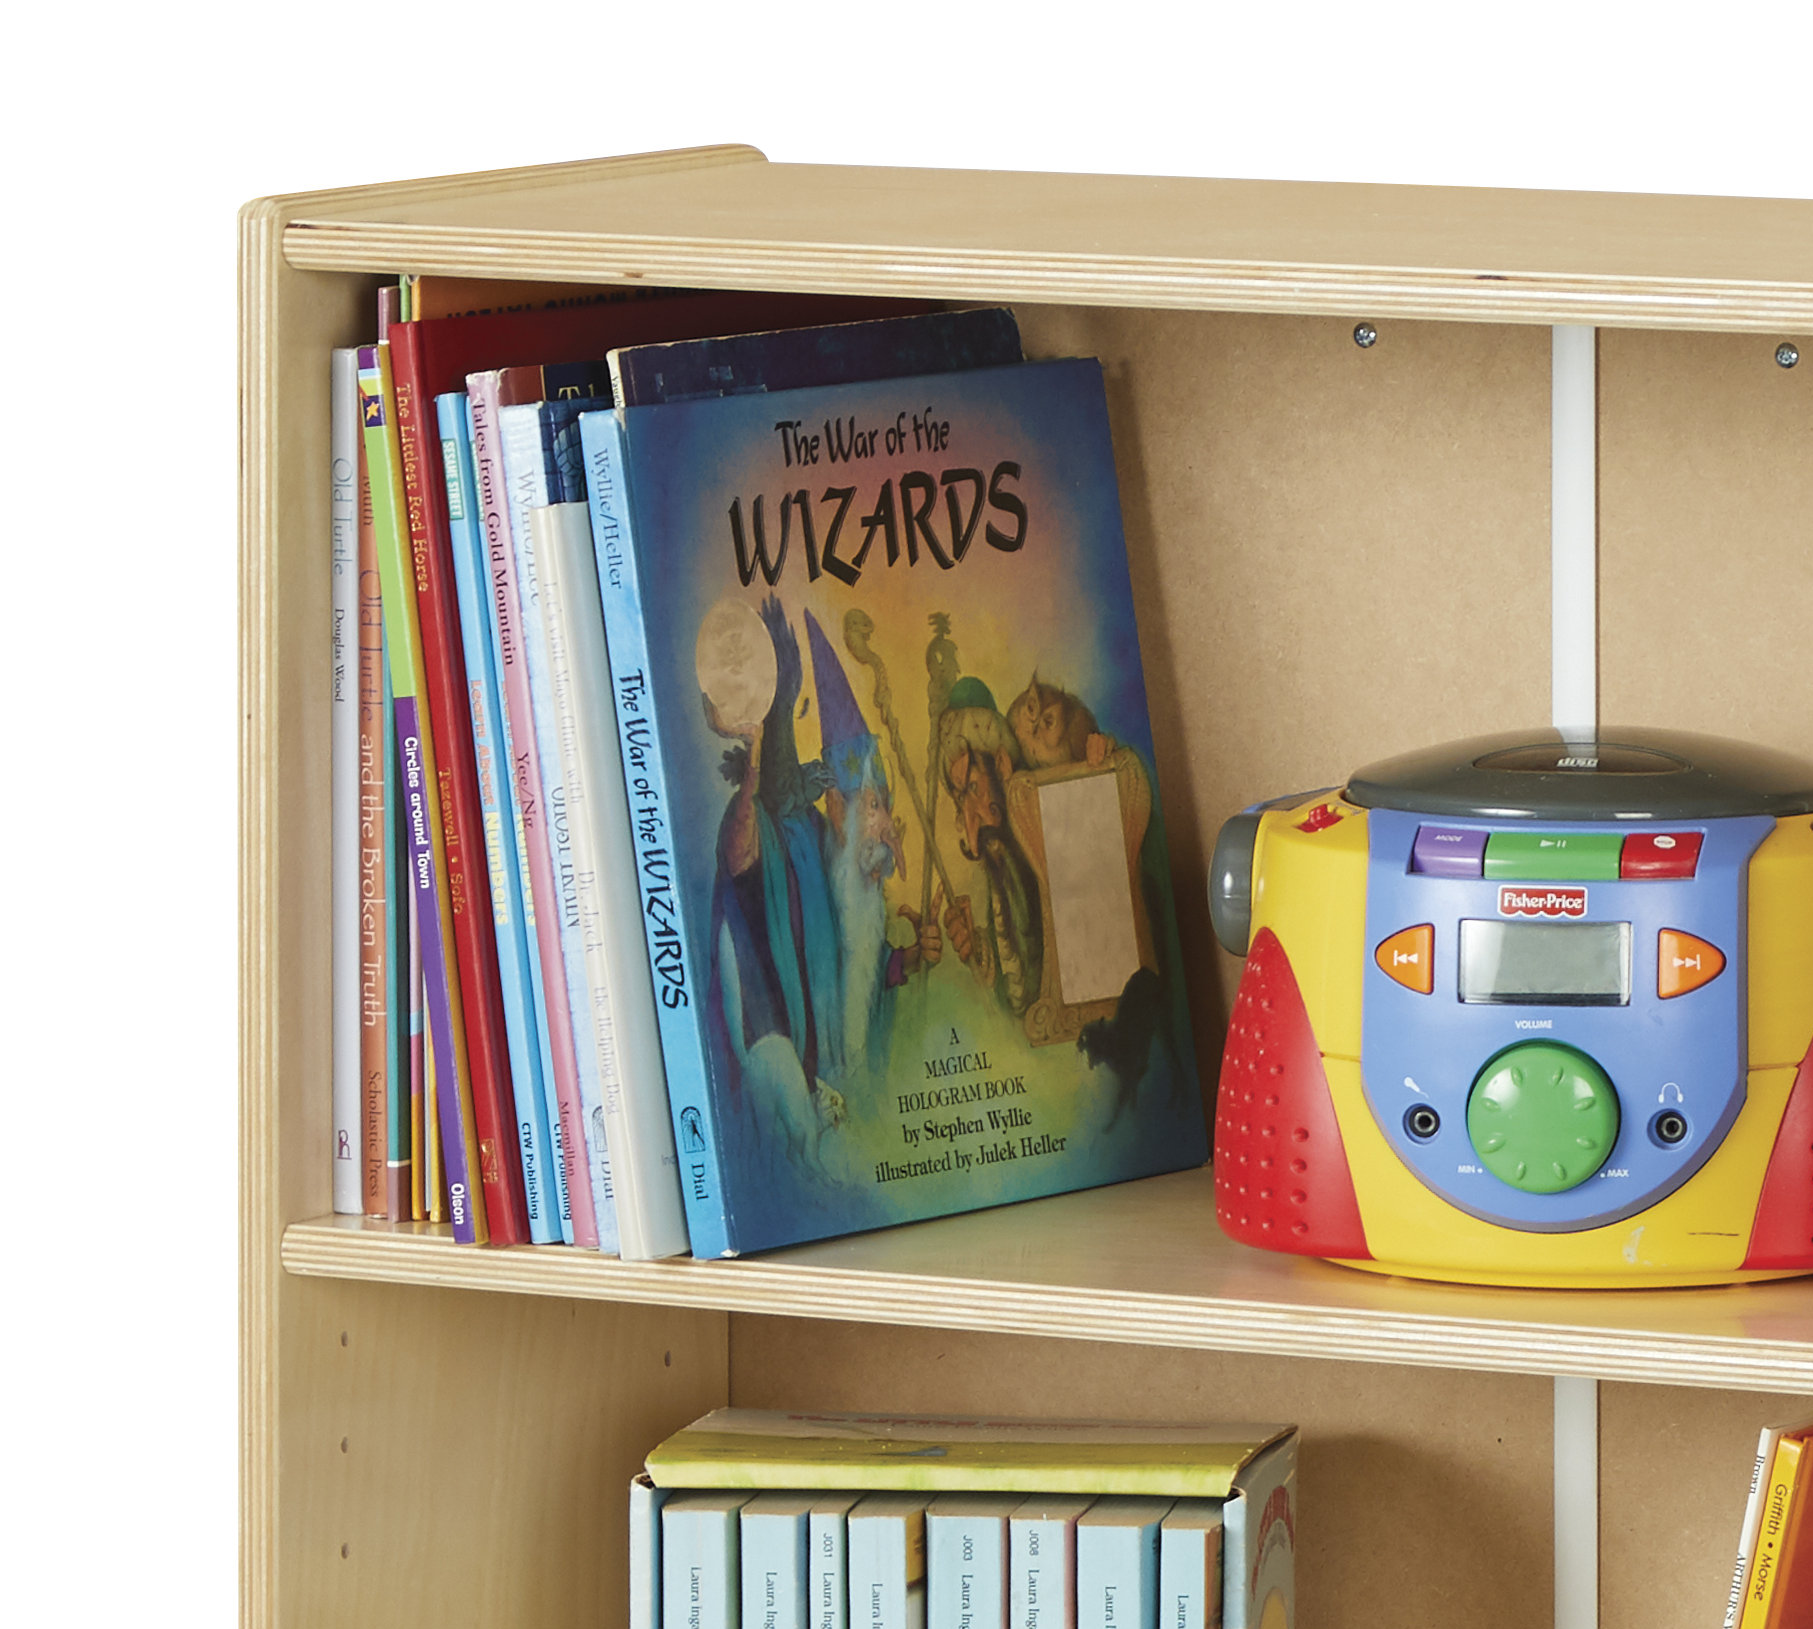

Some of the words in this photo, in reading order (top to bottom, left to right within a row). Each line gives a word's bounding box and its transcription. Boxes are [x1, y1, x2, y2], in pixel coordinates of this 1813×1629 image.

[775, 420, 820, 467] The
[824, 416, 879, 463] War
[886, 412, 908, 457] of
[913, 407, 949, 452] the
[591, 449, 622, 589] Wyllie/Heller
[729, 462, 1029, 588] WIZARDS
[949, 1028, 959, 1045] A
[1515, 1020, 1552, 1029] VOLUME
[924, 1053, 992, 1078] MAGICAL
[898, 1084, 981, 1114] HOLOGRAM
[984, 1076, 1027, 1099] BOOK
[902, 1124, 919, 1148] by
[924, 1117, 983, 1142] Stephen
[987, 1109, 1032, 1134] Wyllie
[875, 1152, 952, 1183] illustrated
[955, 1150, 973, 1172] by
[977, 1141, 1017, 1165] Julek
[1020, 1135, 1067, 1157] Heller
[1458, 1165, 1476, 1174] MIN
[1607, 1169, 1628, 1178] MAX
[691, 1164, 708, 1200] Dial
